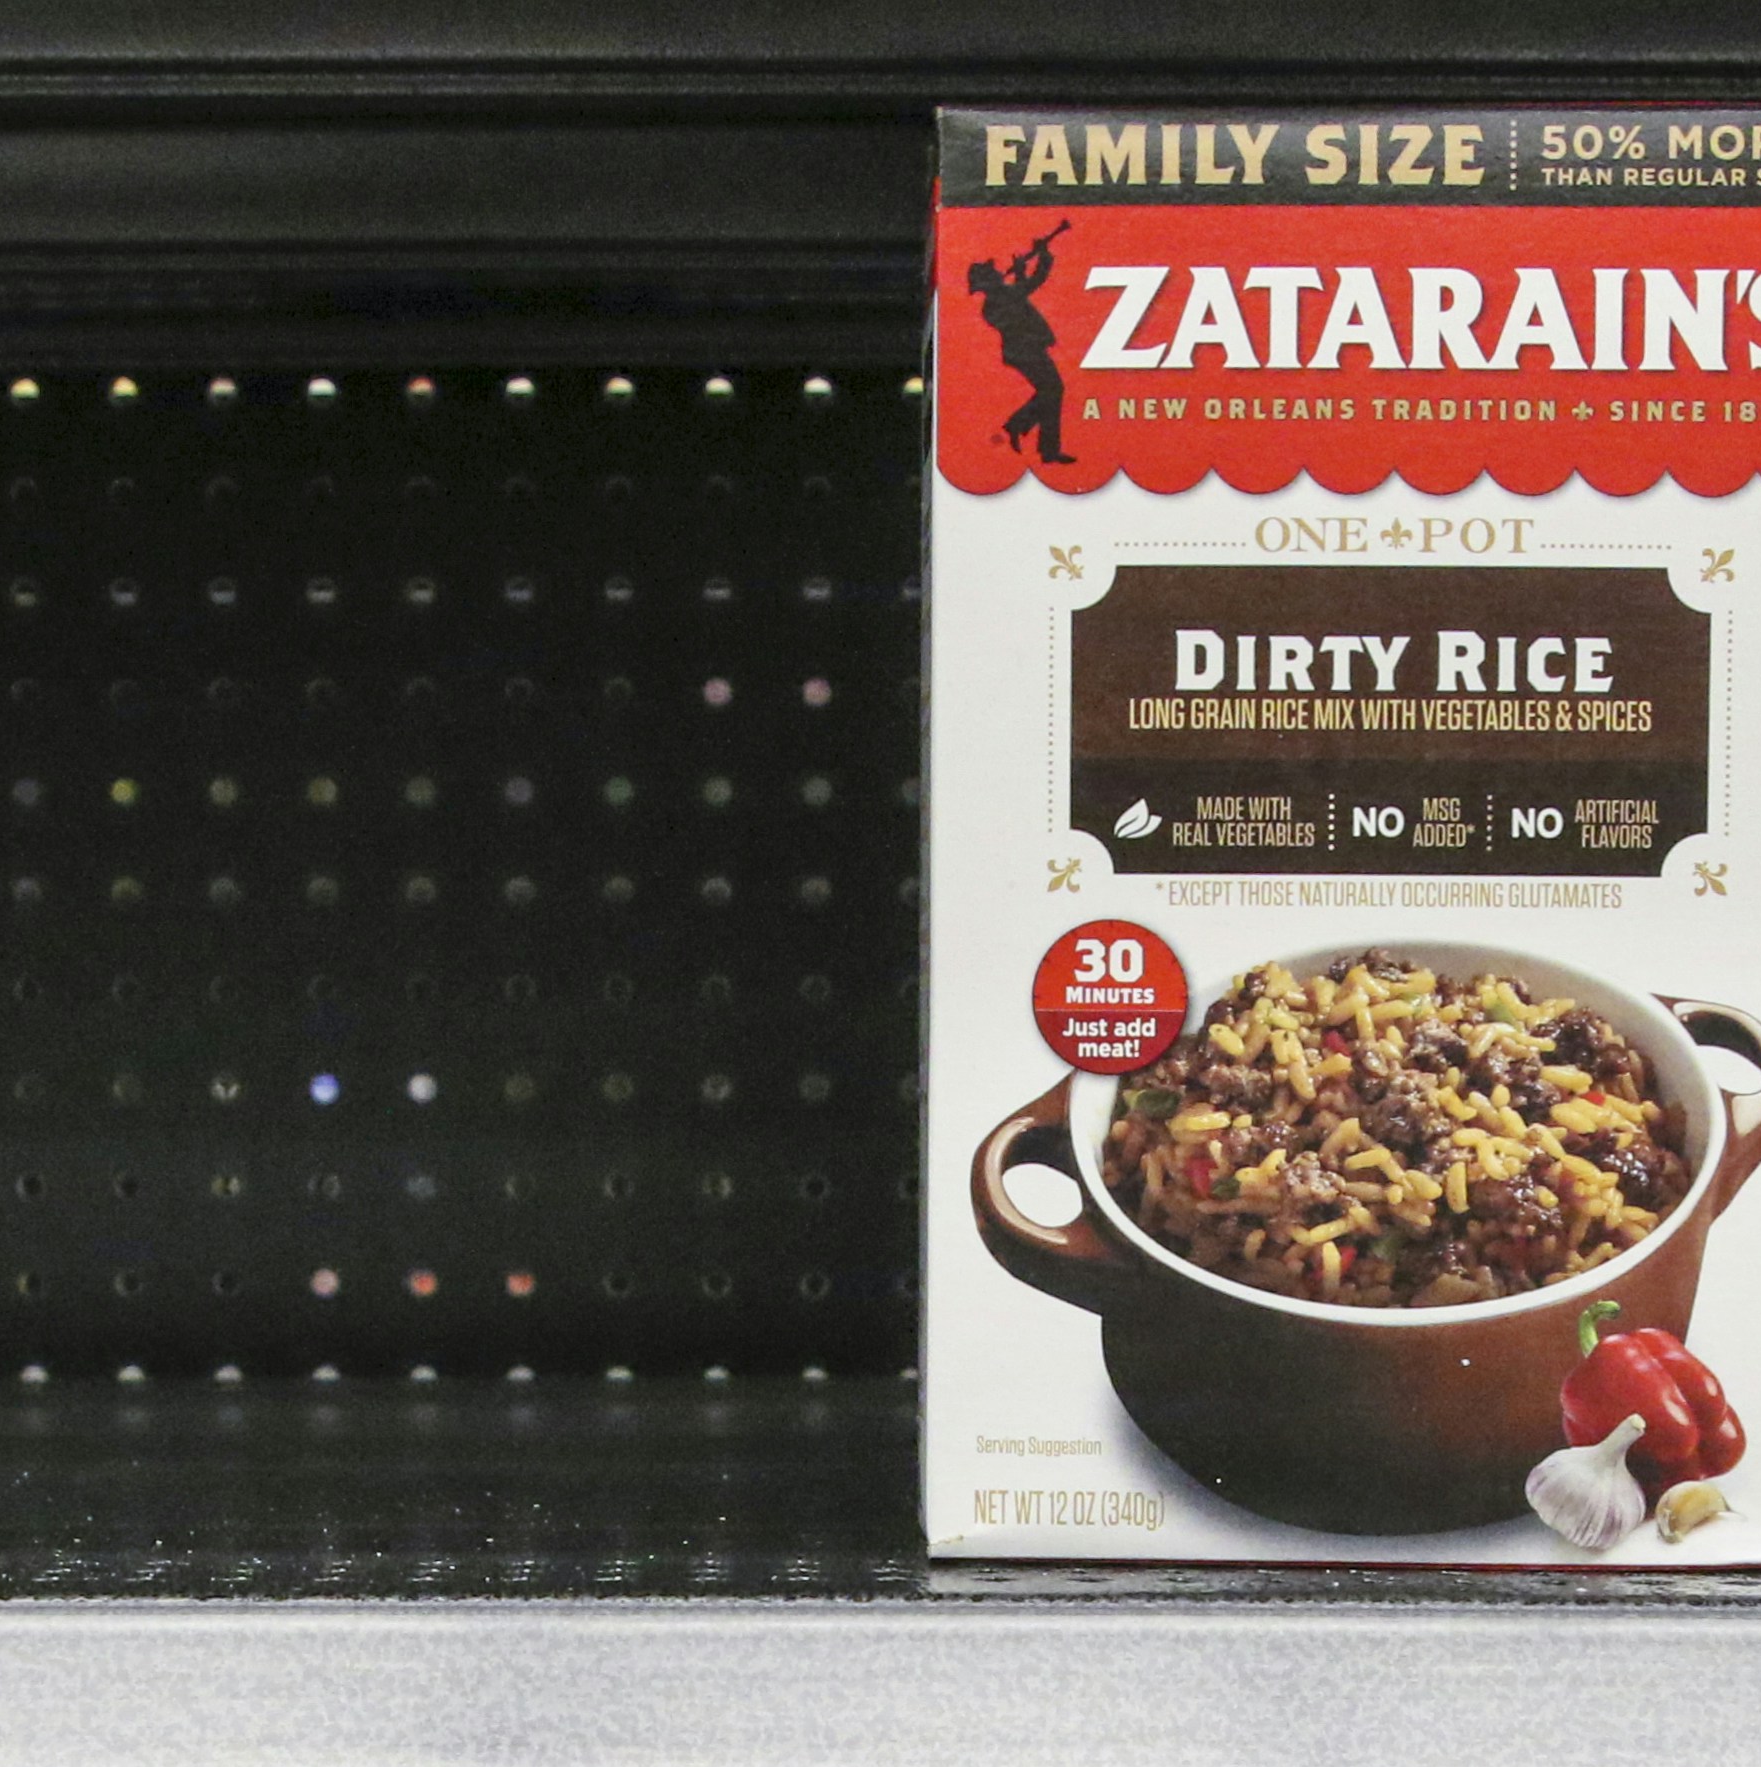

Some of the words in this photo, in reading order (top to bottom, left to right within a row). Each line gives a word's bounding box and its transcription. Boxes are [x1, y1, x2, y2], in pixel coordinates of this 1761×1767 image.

[984, 124, 1279, 186] FAMILY
[1305, 123, 1485, 186] SIZE
[1541, 124, 1646, 160] 50%
[1541, 168, 1612, 186] THAN
[1624, 168, 1746, 186] REGULAR
[1083, 398, 1101, 420] A
[1119, 398, 1187, 420] NEW
[1204, 398, 1356, 421] ORLEANS
[1372, 399, 1557, 422] TRADITION
[1610, 401, 1706, 422] SINCE
[1254, 517, 1368, 554] ONE
[1418, 518, 1534, 555] POT
[1175, 630, 1410, 692] DIRTY
[1437, 631, 1613, 693] RICE
[1129, 698, 1185, 729] LONG
[1191, 698, 1256, 729] GRAIN
[1262, 699, 1309, 729] RICE
[1314, 699, 1355, 730] MIX
[1361, 699, 1416, 730] WITH
[1422, 700, 1550, 731] VEGETABLES
[1555, 701, 1572, 731] &
[1578, 701, 1652, 732] SPICES
[1197, 797, 1244, 820] MADE
[1248, 797, 1291, 820] WITH
[1423, 797, 1460, 821] MSG
[1574, 799, 1659, 824] ARTIFICIAL
[1172, 822, 1212, 846] REAL
[1217, 822, 1315, 847] VEGETABLES
[1352, 807, 1405, 837] NO
[1511, 808, 1564, 838] NO
[1582, 825, 1652, 849] FLAVORS
[1239, 881, 1294, 906] THOSE
[1299, 881, 1396, 907] NATURALLY
[1401, 882, 1503, 908] OCCURRING
[1509, 882, 1622, 909] GLUTAMATES
[1074, 939, 1144, 982] 30
[1066, 986, 1155, 1004] MINUTES
[1062, 1018, 1108, 1037] Just
[1114, 1018, 1156, 1037] add
[1078, 1040, 1140, 1058] meat!
[977, 1436, 1025, 1456] Serving
[1028, 1436, 1102, 1456] Suggestion
[974, 1489, 1009, 1524] NET
[1014, 1490, 1044, 1524] WT
[1049, 1491, 1068, 1525] 12
[1073, 1491, 1096, 1525] OZ
[1101, 1491, 1165, 1531] (340g)
